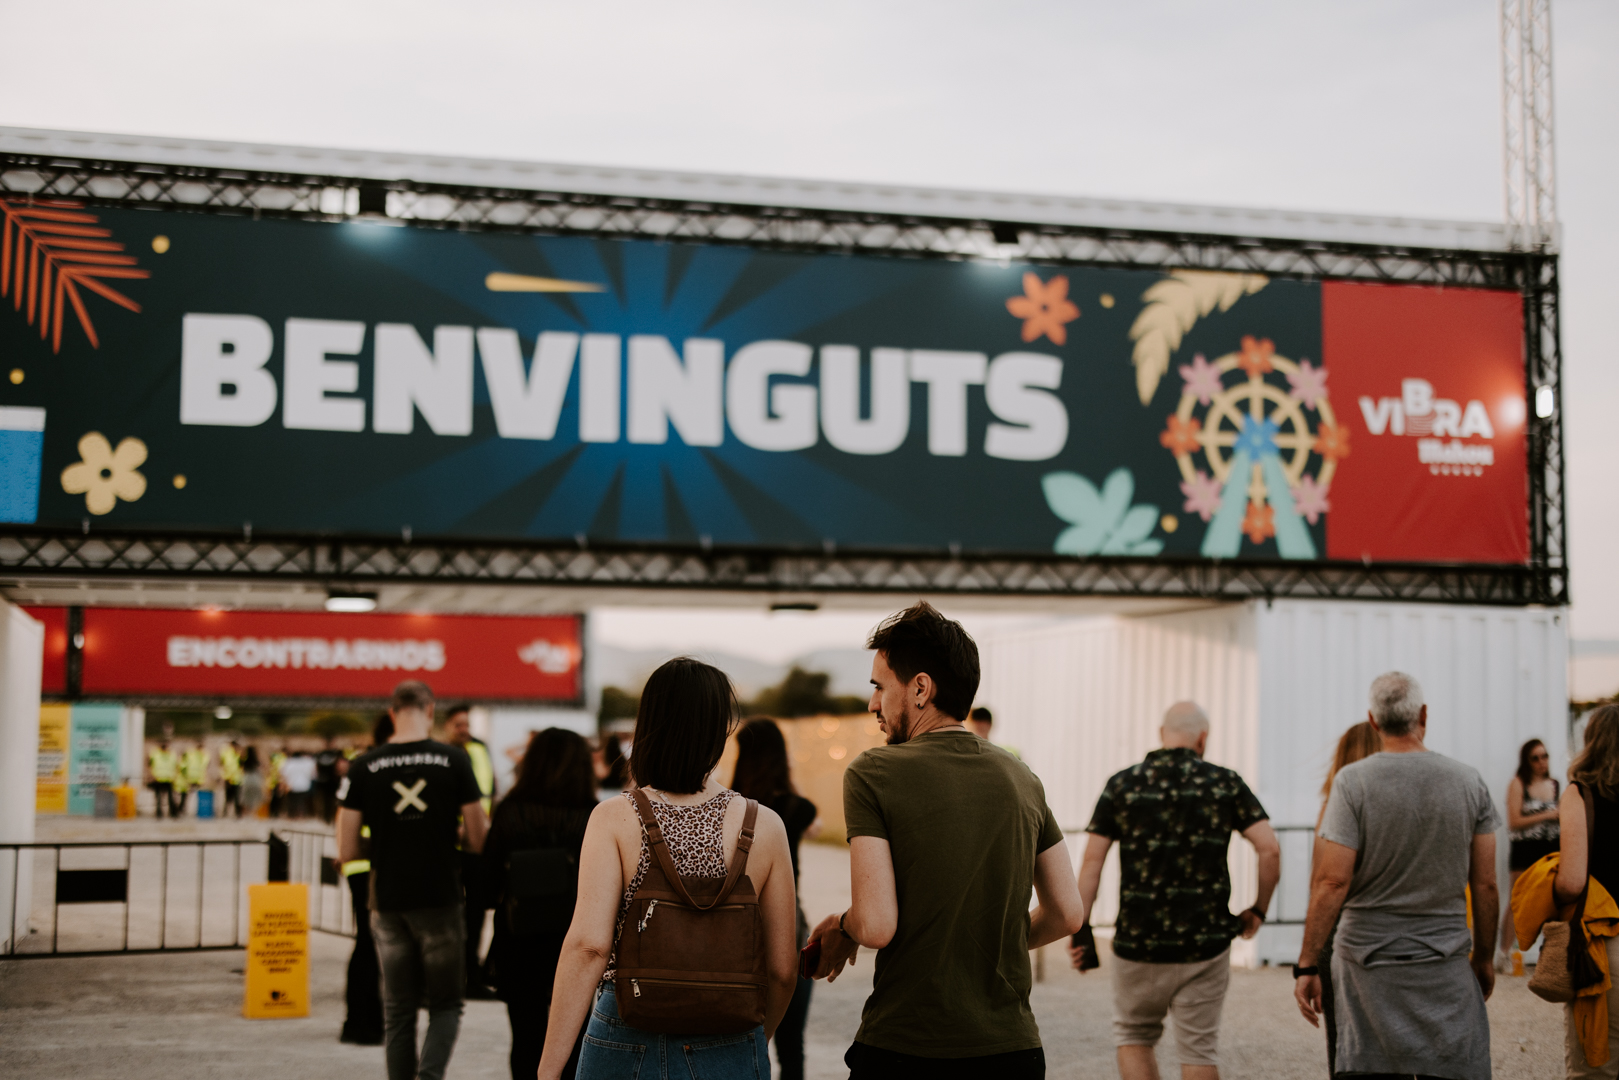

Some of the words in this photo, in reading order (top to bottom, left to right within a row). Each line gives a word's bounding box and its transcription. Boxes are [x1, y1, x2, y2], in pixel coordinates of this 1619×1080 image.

[180, 312, 1069, 462] BENVINGUTS
[1358, 377, 1494, 439] VIBRA
[167, 637, 446, 671] ENCONTRARNOS
[367, 752, 450, 773] UNIVERSAL
